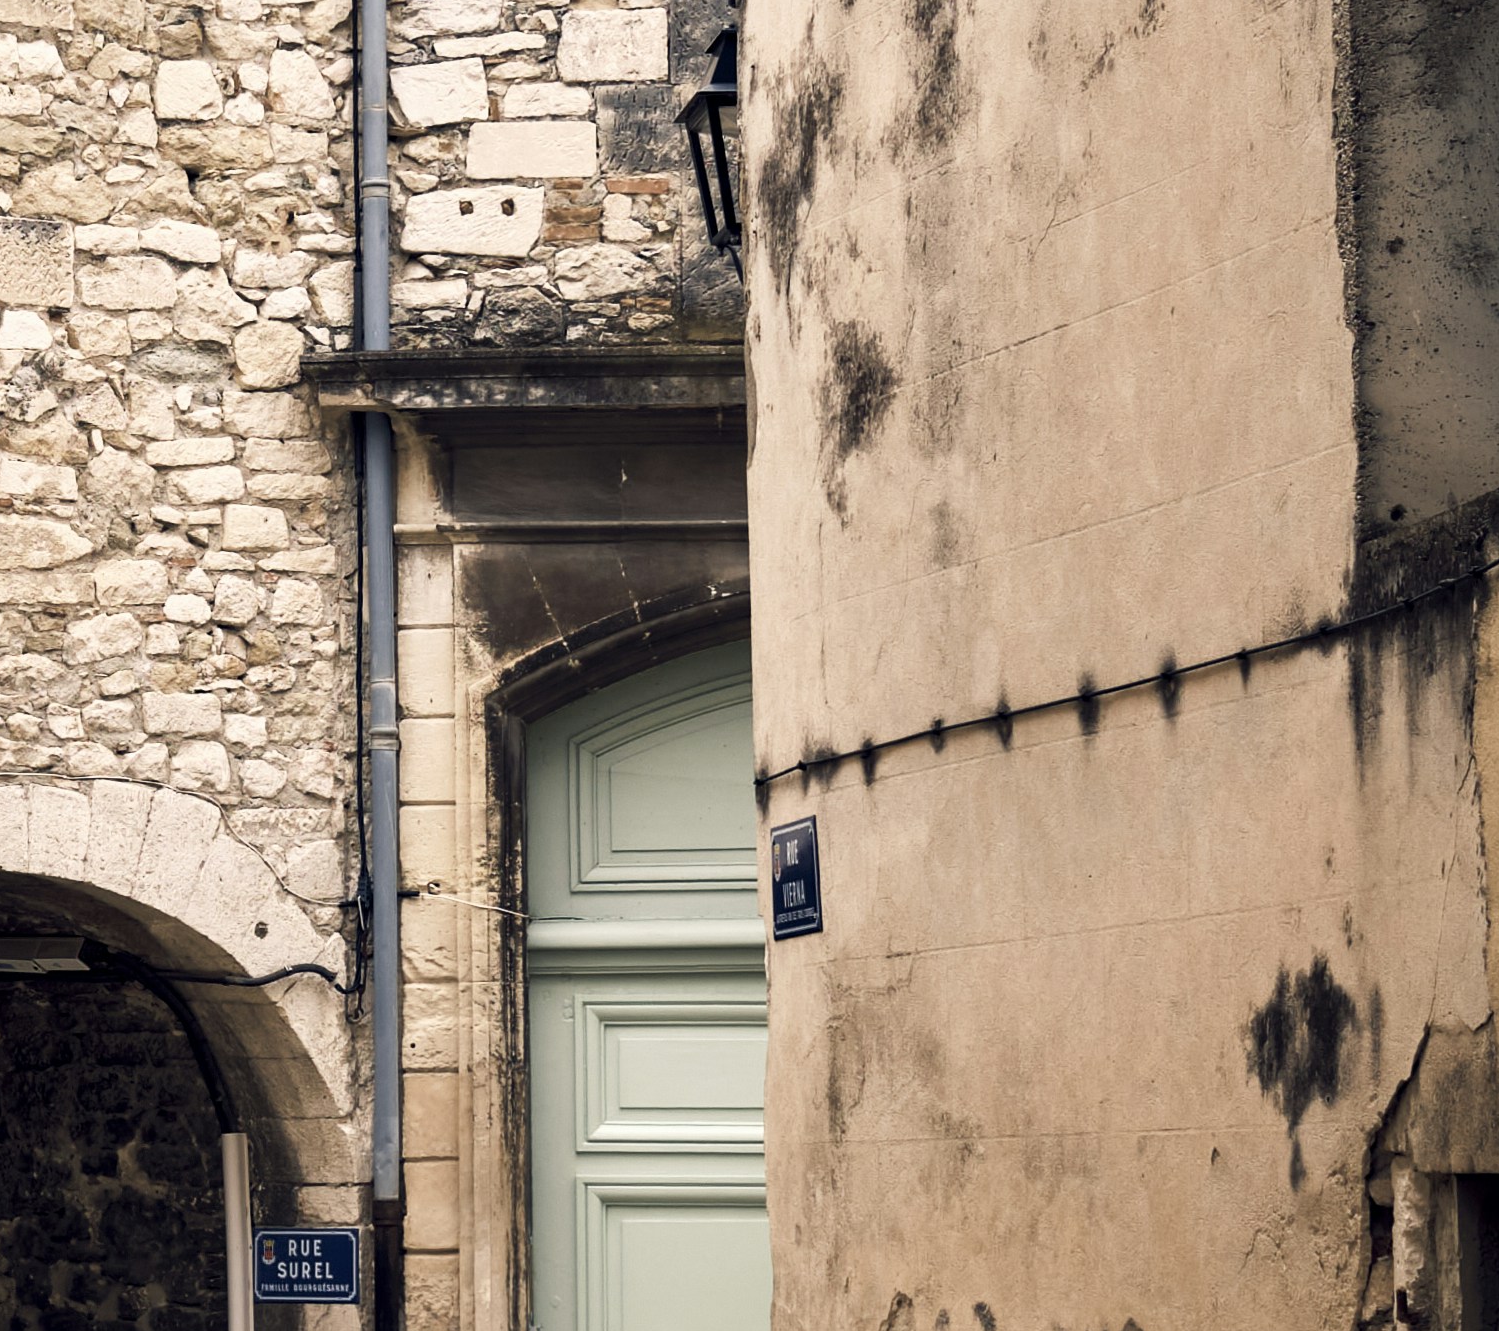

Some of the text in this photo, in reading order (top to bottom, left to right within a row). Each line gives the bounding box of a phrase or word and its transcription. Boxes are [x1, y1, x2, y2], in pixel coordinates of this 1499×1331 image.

[786, 839, 799, 867] RUE
[782, 879, 806, 908] VIERNA
[288, 1239, 322, 1257] RUE
[277, 1262, 334, 1279] SUREL
[261, 1283, 290, 1293] FAMILLE
